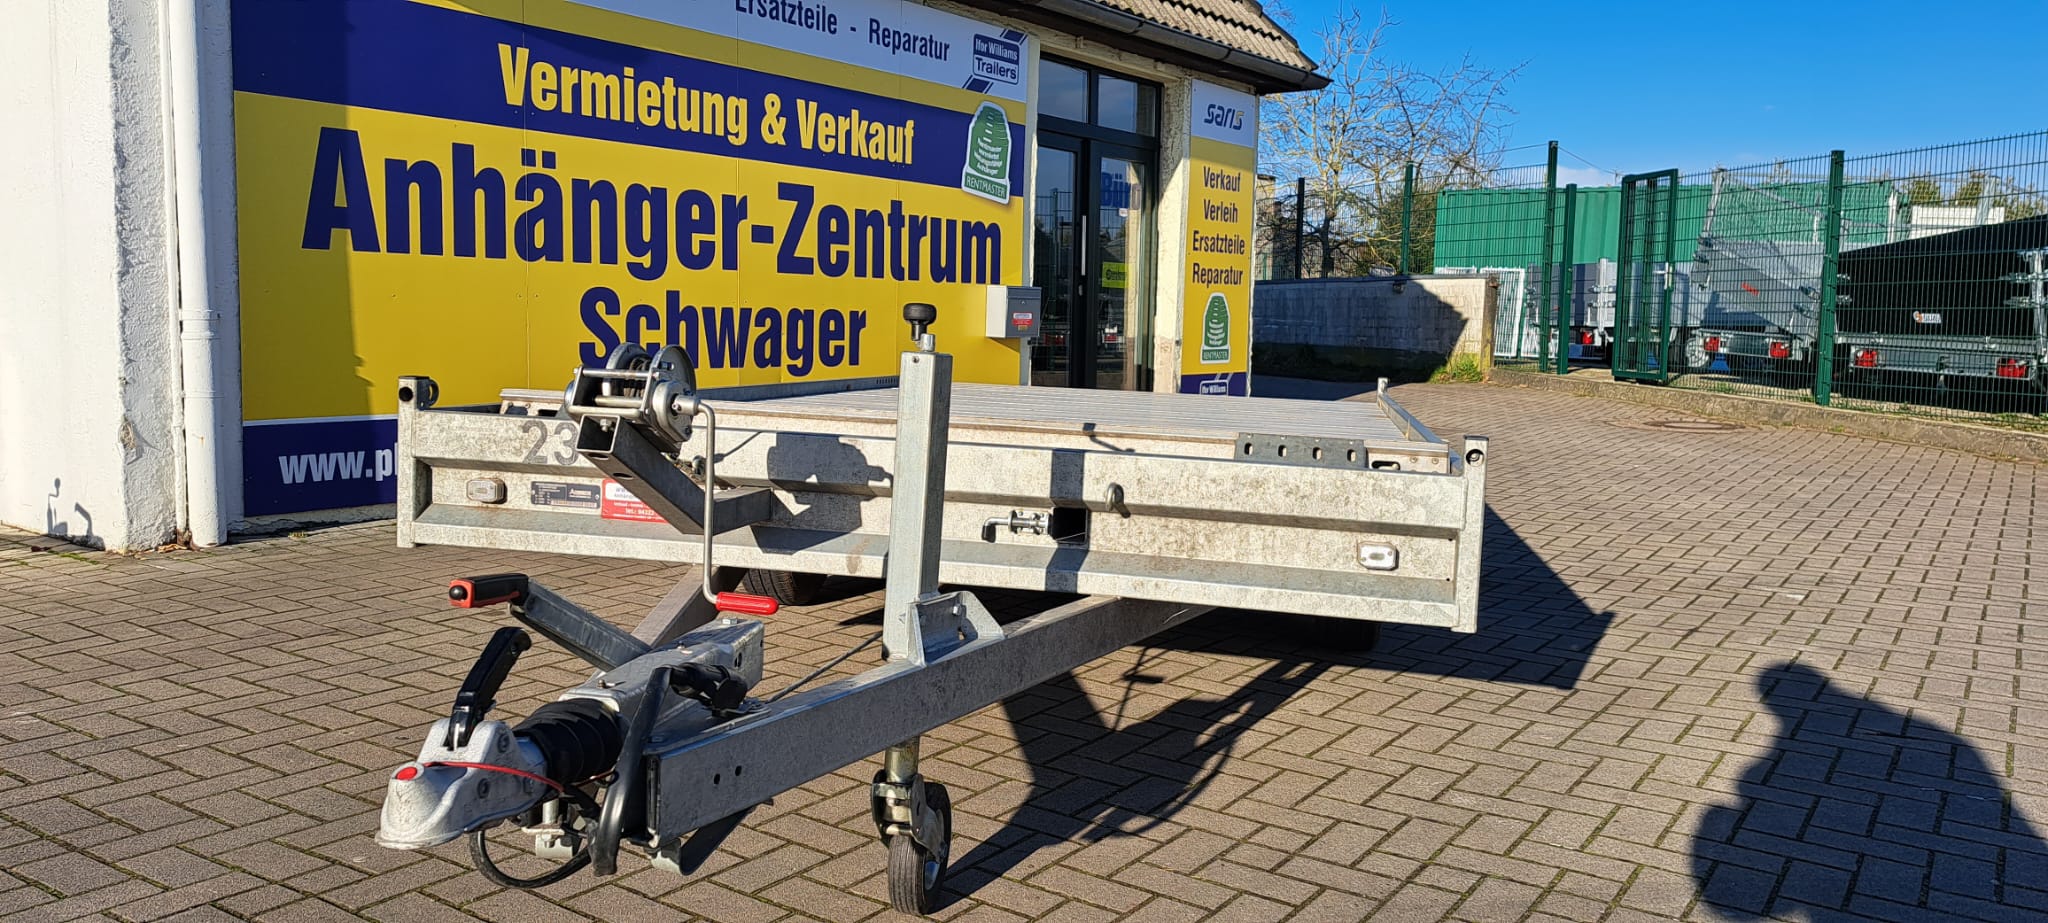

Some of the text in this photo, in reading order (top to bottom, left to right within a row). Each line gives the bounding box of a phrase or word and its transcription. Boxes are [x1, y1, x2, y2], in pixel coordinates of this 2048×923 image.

[869, 18, 950, 62] Reparatur
[975, 38, 1018, 60] Ifor Williams
[975, 57, 1017, 79] Trailers
[498, 43, 914, 164] Vermietung & Verkauf
[1204, 103, 1244, 131] saris
[966, 176, 1006, 198] RENTMASTER
[1203, 166, 1241, 192] Verkauf
[302, 126, 1001, 285] Anhänger-Zentrum
[1203, 199, 1238, 223] Verleih
[1193, 230, 1245, 255] Ersatzteile
[1192, 262, 1243, 289] Reparatur
[579, 287, 866, 377] Schwager
[522, 420, 579, 466] 23
[279, 442, 398, 484] www.p
